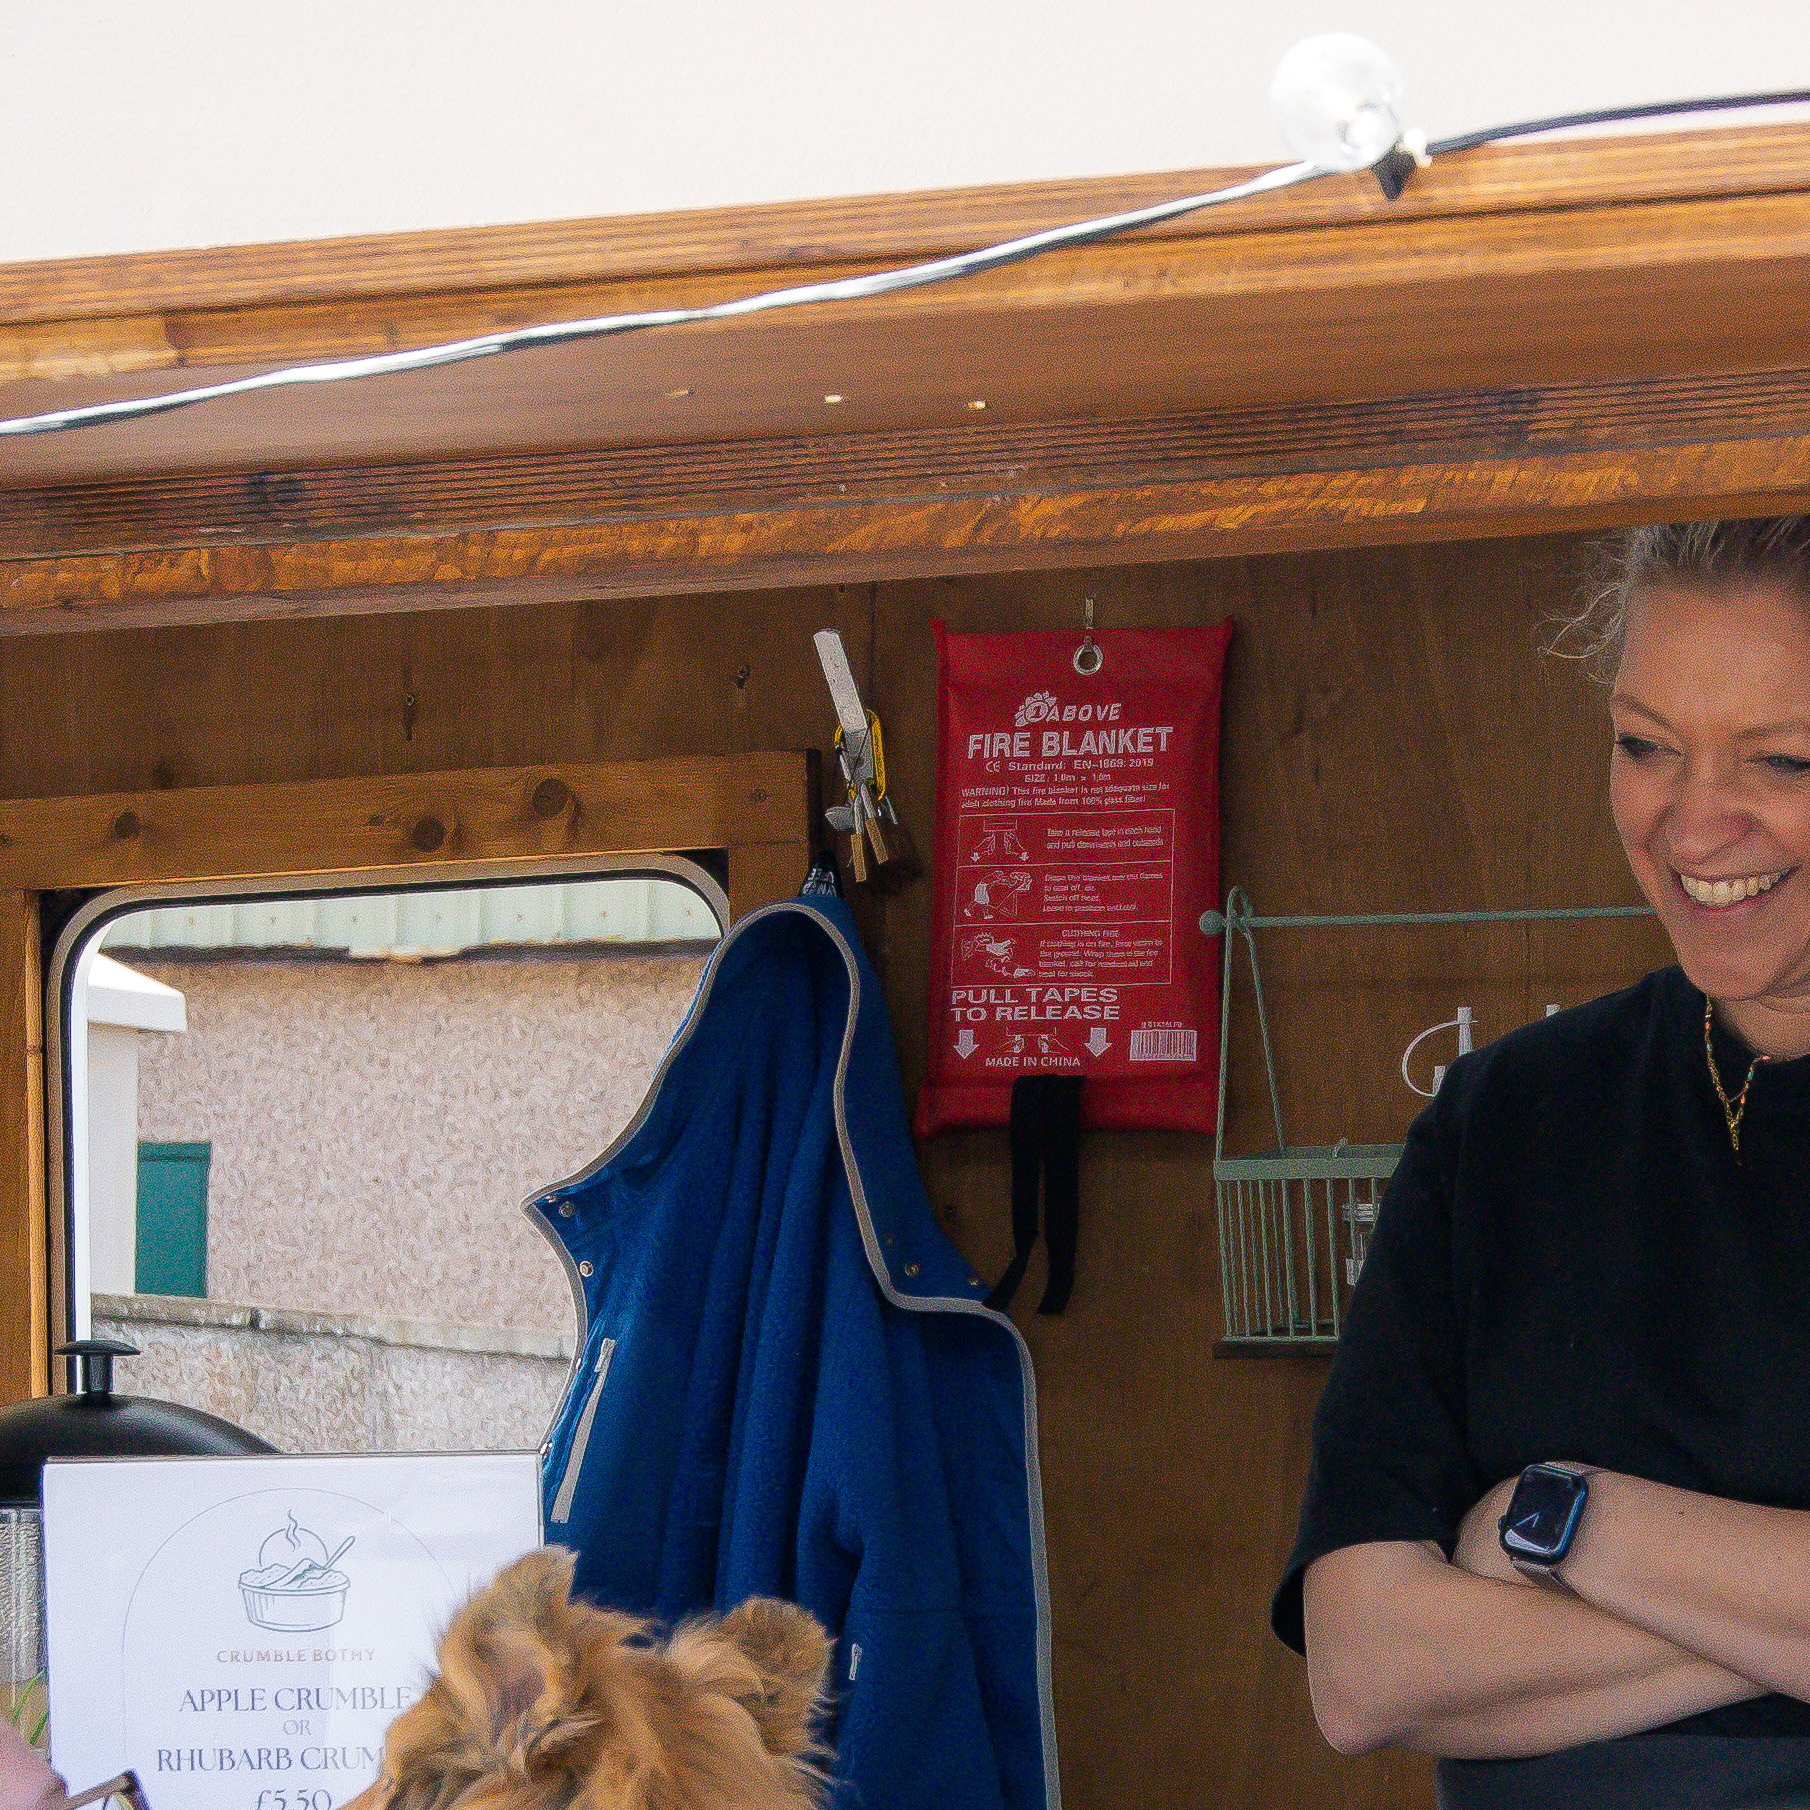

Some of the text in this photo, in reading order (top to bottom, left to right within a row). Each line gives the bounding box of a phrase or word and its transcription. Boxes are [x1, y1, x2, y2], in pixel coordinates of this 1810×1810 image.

[968, 726, 1173, 759] FIRE BLANKET
[951, 987, 1118, 1005] PULL TAPES
[950, 1005, 1120, 1022] TO RELEASE
[986, 1056, 1081, 1067] MADE IN CHINA
[216, 1647, 376, 1664] CRUMBLE BOTHY
[178, 1685, 413, 1713] APPLE CRUMBLE
[282, 1718, 312, 1736] OR
[157, 1746, 384, 1772] RHUBARB CRUM
